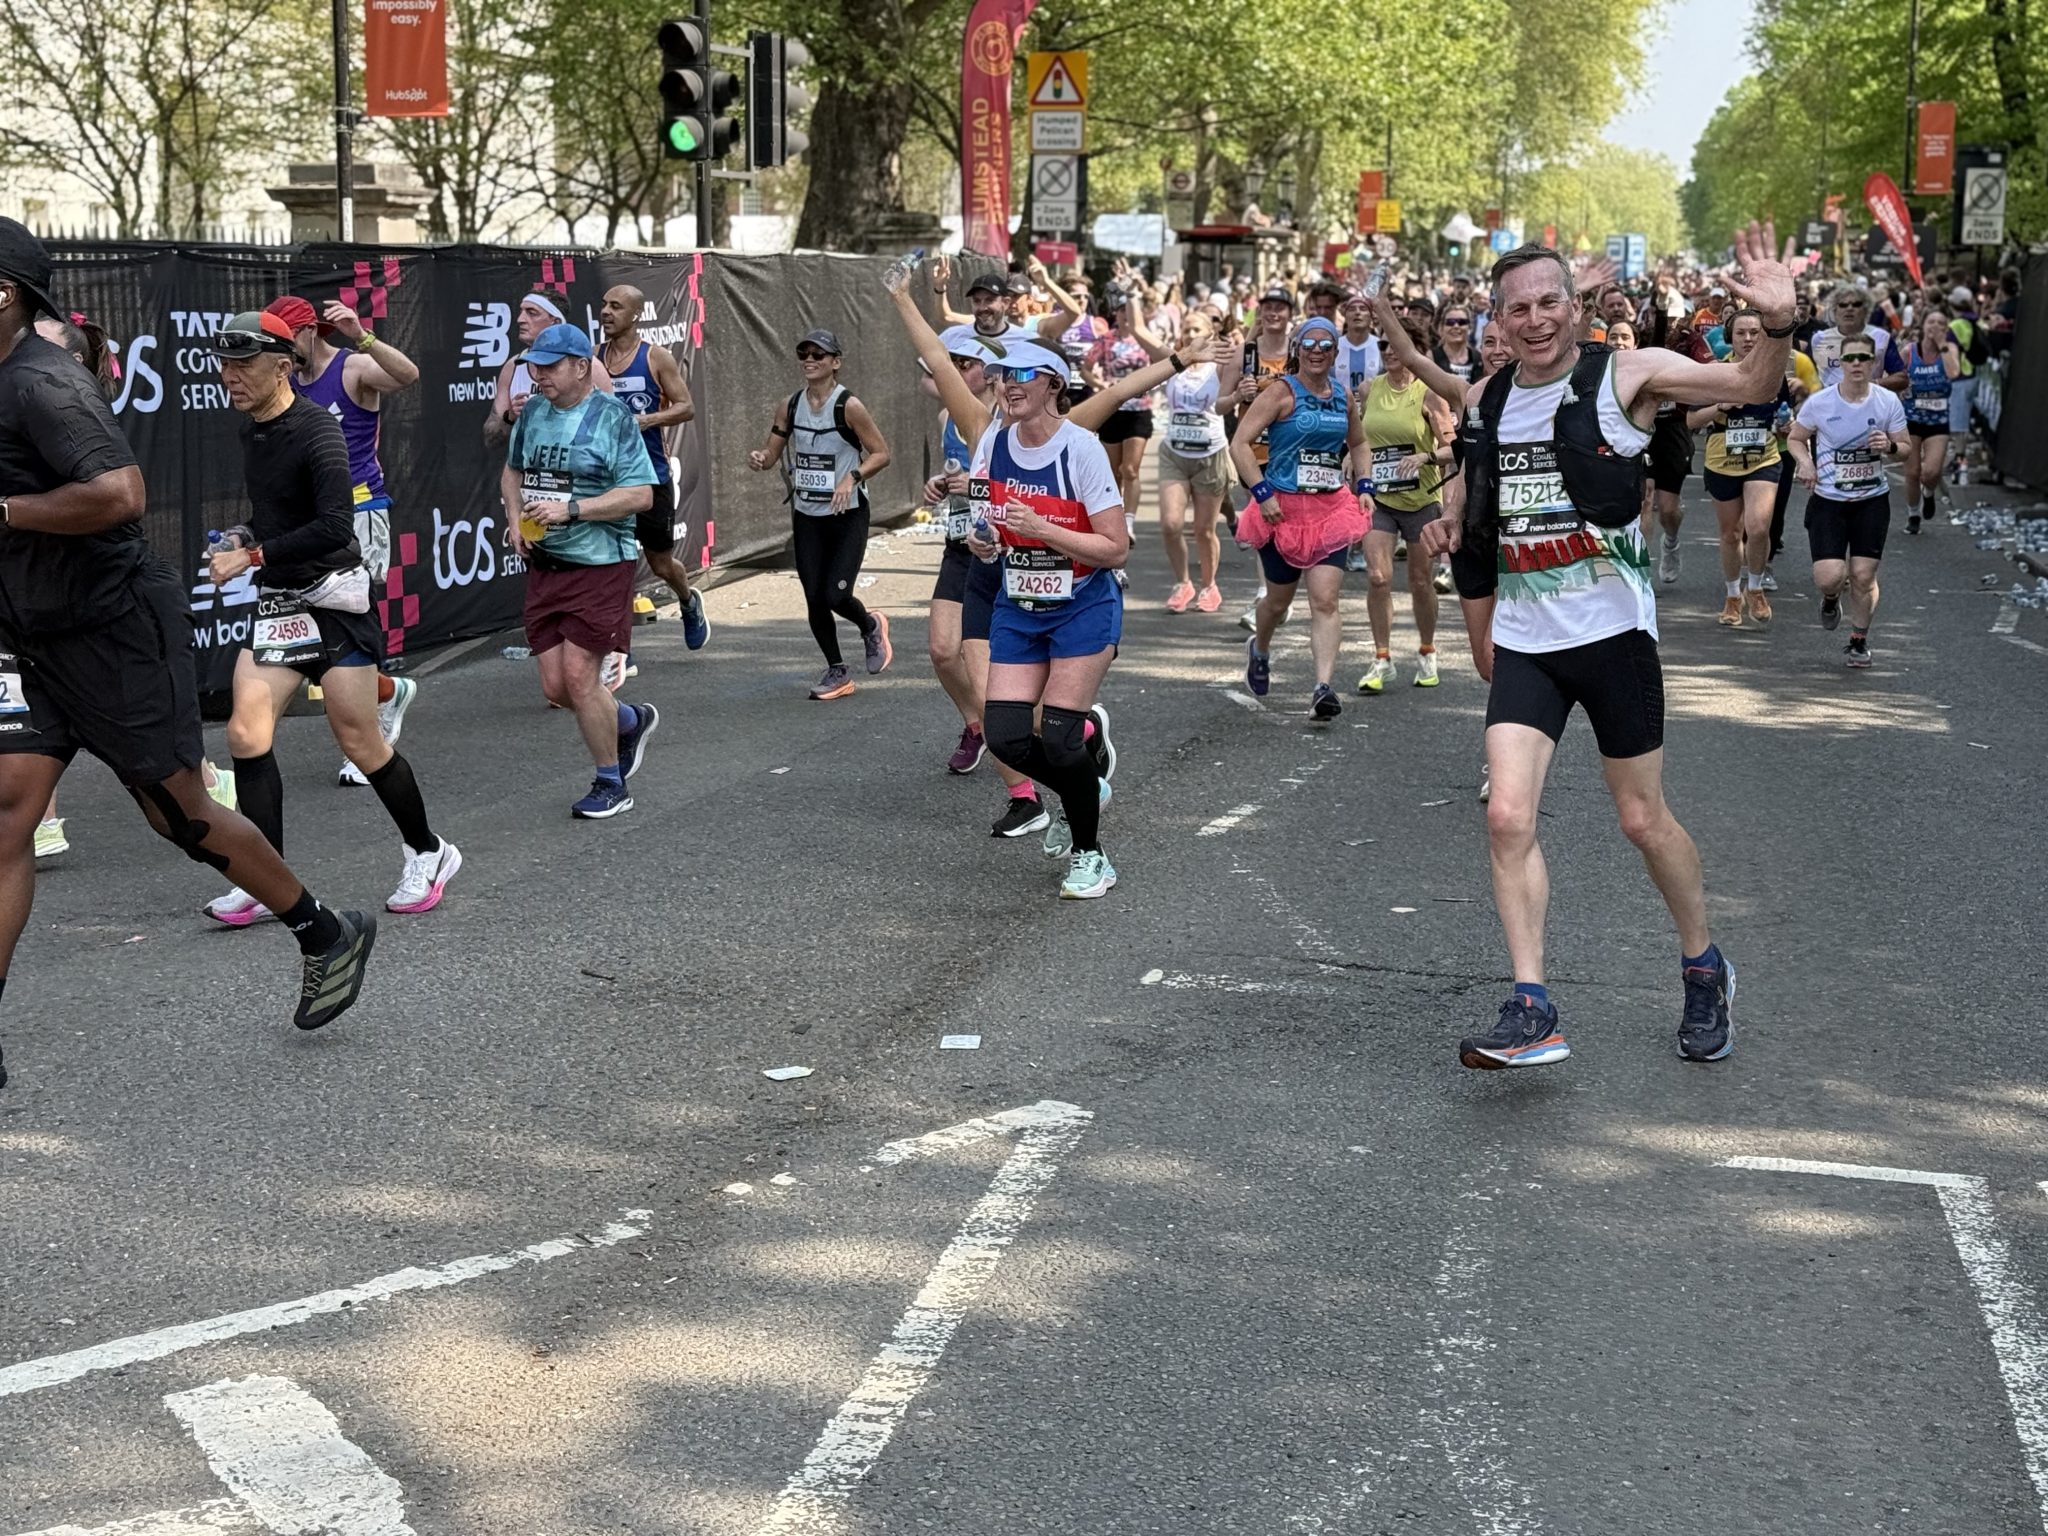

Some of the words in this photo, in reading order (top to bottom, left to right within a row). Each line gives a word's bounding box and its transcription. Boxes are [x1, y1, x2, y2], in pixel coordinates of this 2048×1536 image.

[372, 0, 438, 12] impossibly
[390, 14, 422, 27] easy.
[385, 88, 428, 102] HubSpot
[1036, 115, 1078, 126] Humped
[1039, 126, 1076, 135] Pelican
[1036, 137, 1078, 148] crossing
[972, 97, 990, 241] PLUMSTEAD
[1043, 204, 1066, 214] Zone
[1036, 215, 1072, 227] ENDS
[1972, 218, 1994, 228] Zone
[1966, 229, 1999, 240] ENDS
[1350, 371, 1365, 388] 10
[449, 382, 476, 403] new
[1727, 418, 1744, 428] tcs
[1176, 429, 1203, 439] 53937
[797, 454, 809, 468] tcs
[1498, 450, 1529, 472] tcs
[1836, 450, 1855, 463] tcs
[523, 470, 539, 487] tcs
[1841, 466, 1874, 479] 26883
[800, 473, 827, 487] 55039
[971, 481, 990, 498] tcs
[1004, 477, 1048, 499] Pippa
[1049, 514, 1076, 524] Forces
[1529, 525, 1546, 533] new
[1546, 521, 1578, 531] balance
[432, 507, 496, 590] tcs
[1009, 552, 1030, 567] tcs
[1016, 575, 1063, 594] 24262
[258, 599, 279, 616] tcs
[266, 619, 309, 642] 24589
